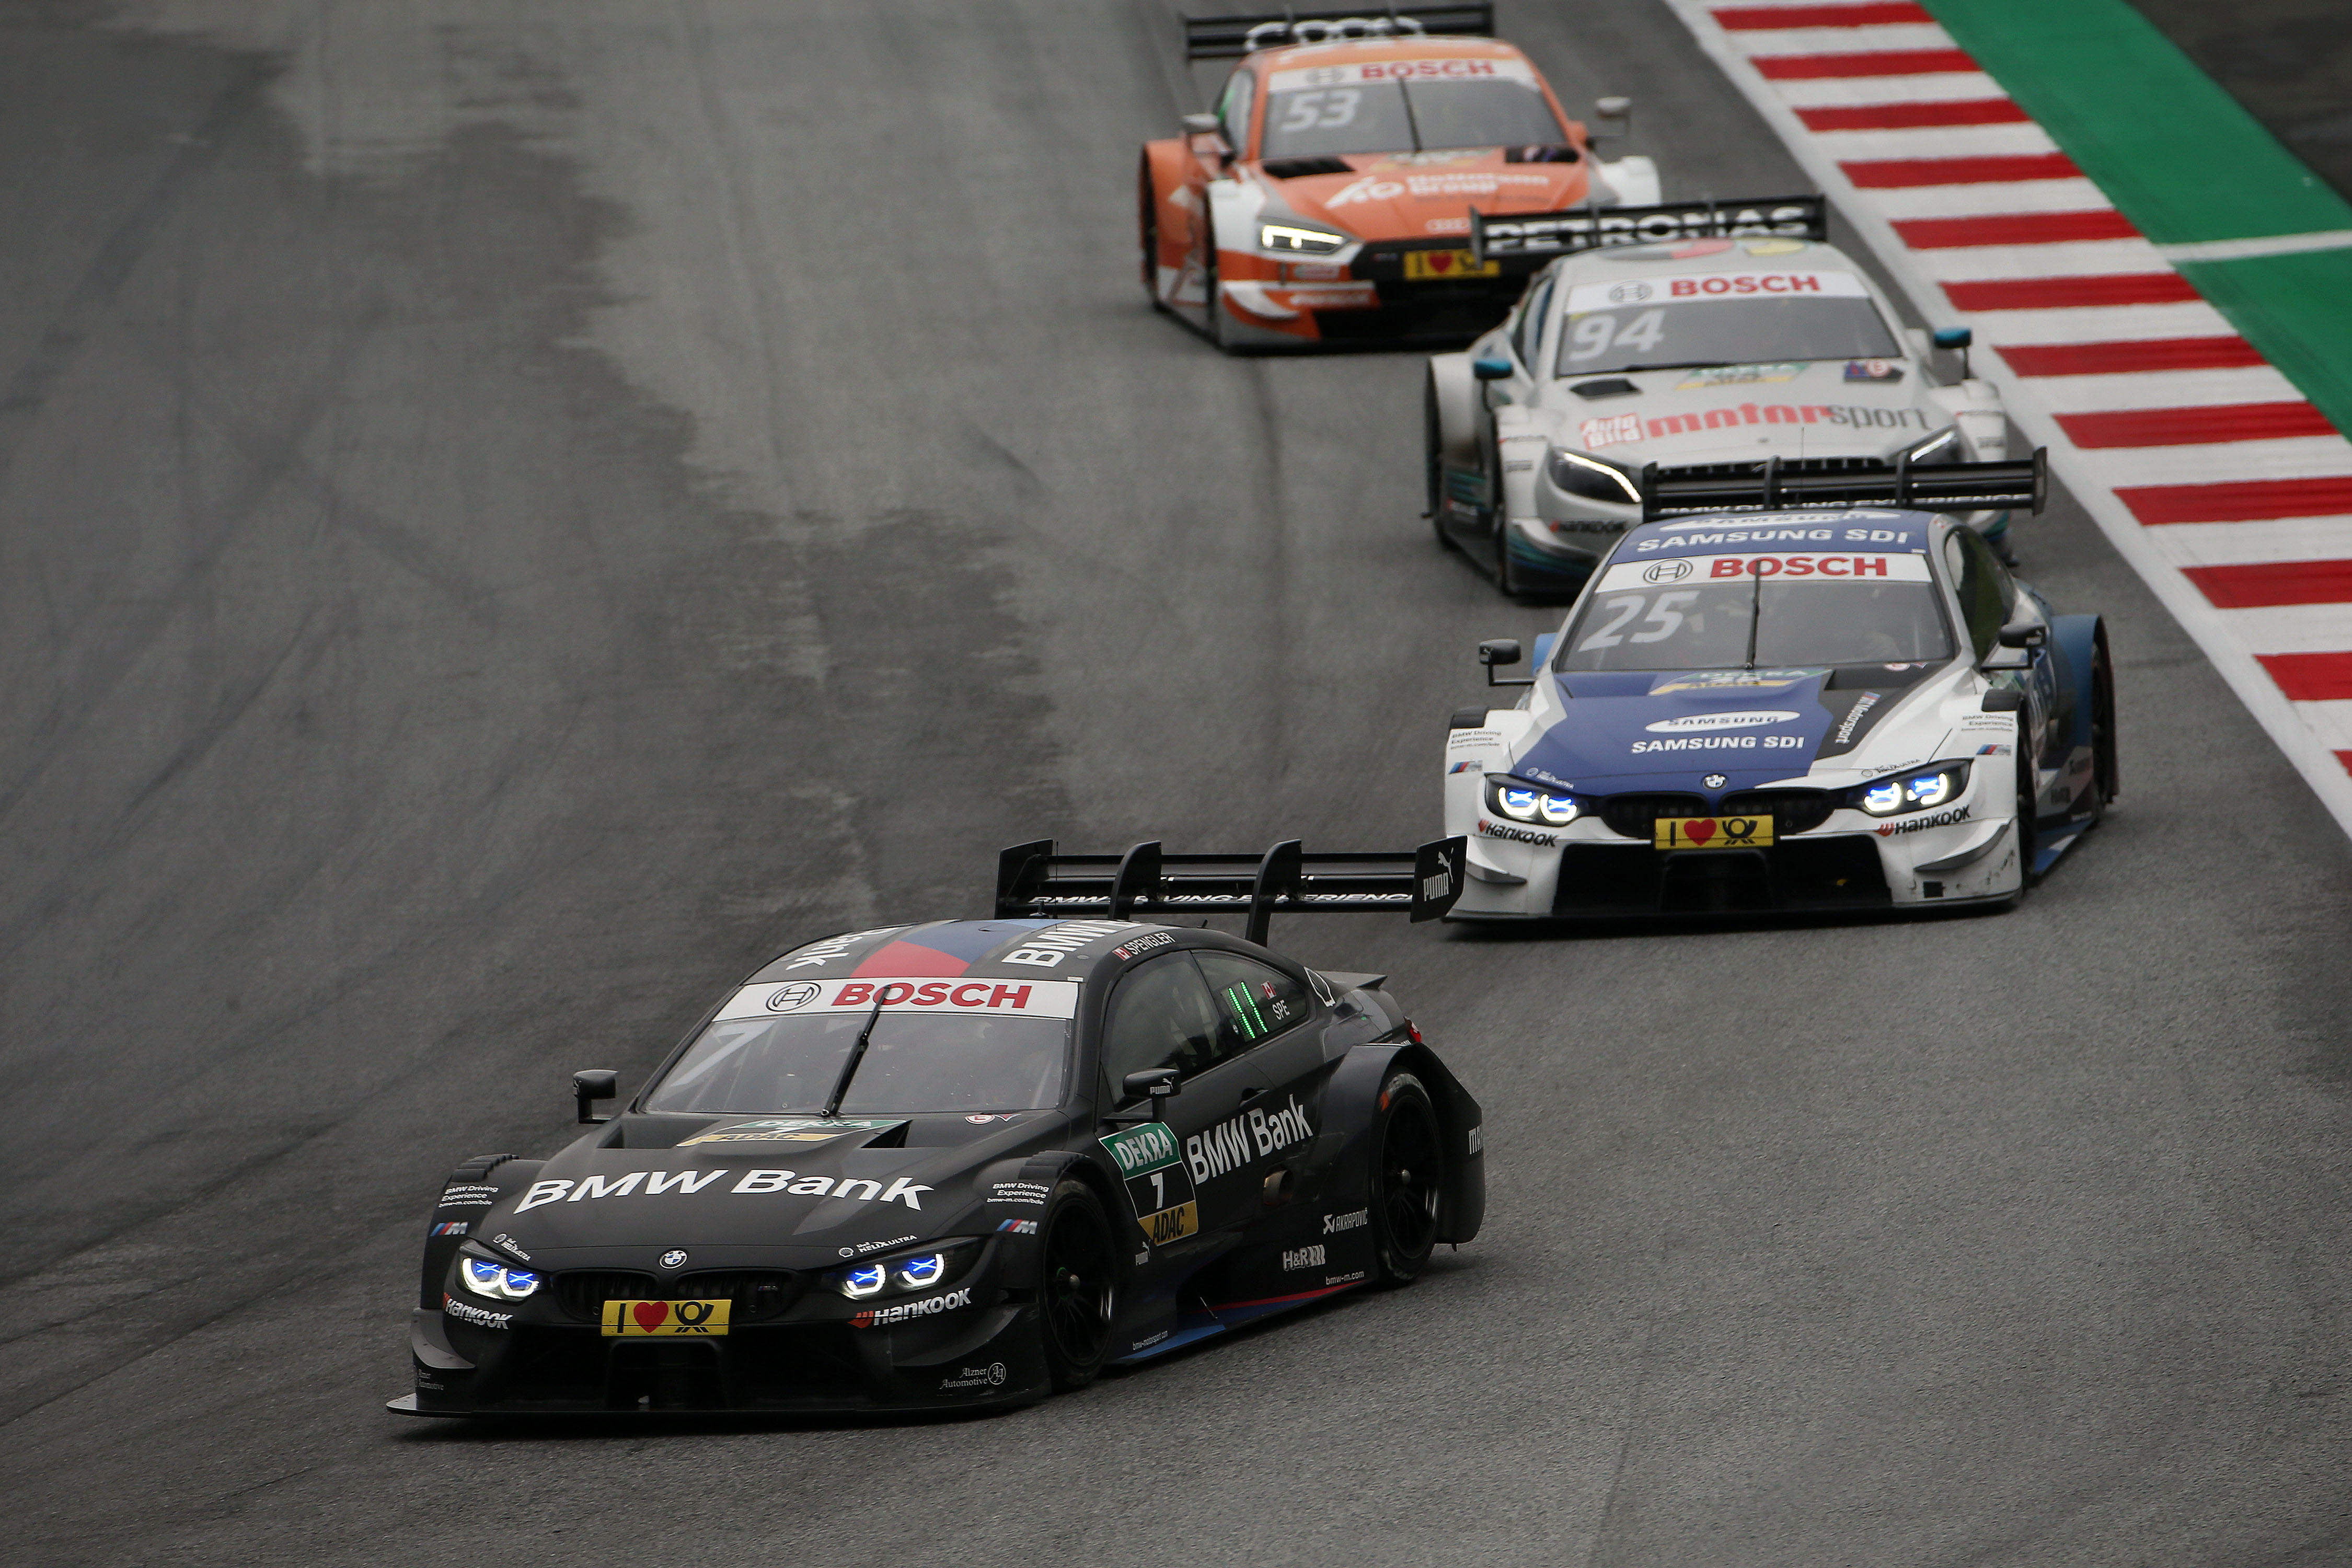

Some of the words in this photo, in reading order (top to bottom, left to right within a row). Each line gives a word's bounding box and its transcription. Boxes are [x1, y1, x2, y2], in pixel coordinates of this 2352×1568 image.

[1362, 60, 1496, 78] BOSCH
[1281, 89, 1361, 132] 53
[1485, 206, 1809, 251] PETRONAS
[1671, 275, 1821, 296] BOSCH
[1570, 309, 1664, 361] 94
[1637, 529, 1832, 554] SAMSUNG
[1845, 529, 1909, 543] SDI
[1710, 557, 1887, 578] BOSCH
[1579, 590, 1699, 652] 25
[1631, 735, 1757, 754] SAMSUNG
[1763, 736, 1805, 750] SDI
[1423, 872, 1449, 902] PUMA
[1001, 924, 1118, 967] BMW
[1123, 932, 1176, 955] SPENGLER
[831, 982, 1032, 1009] BOSCH
[1272, 999, 1291, 1021] SPE
[1114, 1128, 1173, 1171] DEKRA
[1186, 1114, 1251, 1185] BMW
[1248, 1094, 1313, 1157] Bank
[441, 1193, 488, 1202] Experience
[445, 1185, 467, 1195] BMW
[467, 1185, 499, 1193] Driving
[513, 1169, 729, 1215] BMW
[730, 1169, 935, 1211] Bank
[997, 1190, 1046, 1198] Experience
[1017, 1182, 1050, 1192] Driving
[1150, 1172, 1163, 1209] 7
[986, 1196, 1044, 1205] bmw-m.com/bde
[1152, 1206, 1185, 1244] ADAC
[887, 1235, 918, 1244] ULTRA
[1325, 1271, 1365, 1285] bmw-m.com
[939, 1377, 988, 1390] Automotive
[959, 1368, 987, 1378] Alzner
